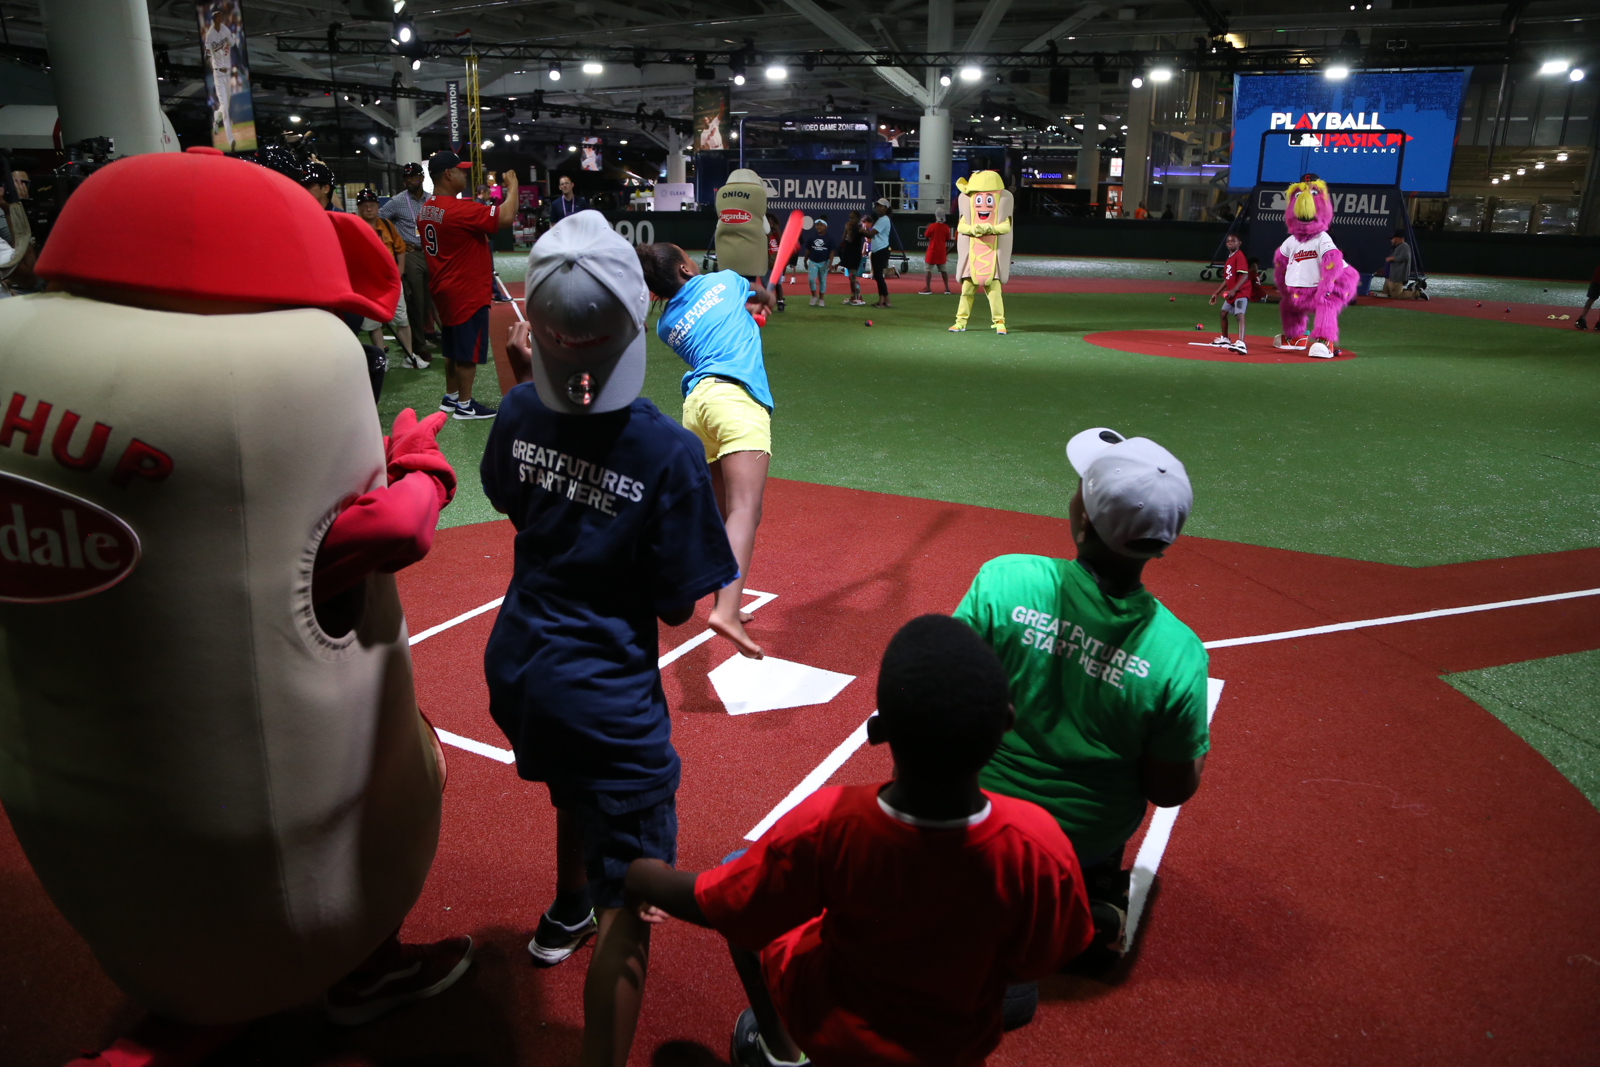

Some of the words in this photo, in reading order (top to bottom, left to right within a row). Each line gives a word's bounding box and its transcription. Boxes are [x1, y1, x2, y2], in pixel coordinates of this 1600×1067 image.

[450, 83, 459, 142] INFORMATION
[801, 123, 818, 131] VIDEO
[819, 123, 837, 131] GAME
[837, 123, 855, 131] ZONE
[722, 190, 751, 200] ONION
[425, 223, 438, 256] 9
[667, 318, 686, 347] GREAT
[684, 283, 726, 322] FUTURES
[674, 317, 696, 347] START
[695, 295, 724, 319] HERE.
[512, 439, 558, 468] GREAT
[555, 453, 645, 502] FUTURES
[519, 463, 566, 493] START
[566, 479, 618, 517] HERE.
[1011, 605, 1071, 636] GREAT
[1069, 625, 1151, 678] FUTURES
[1021, 628, 1079, 659] START
[1078, 650, 1125, 689] HERE.
